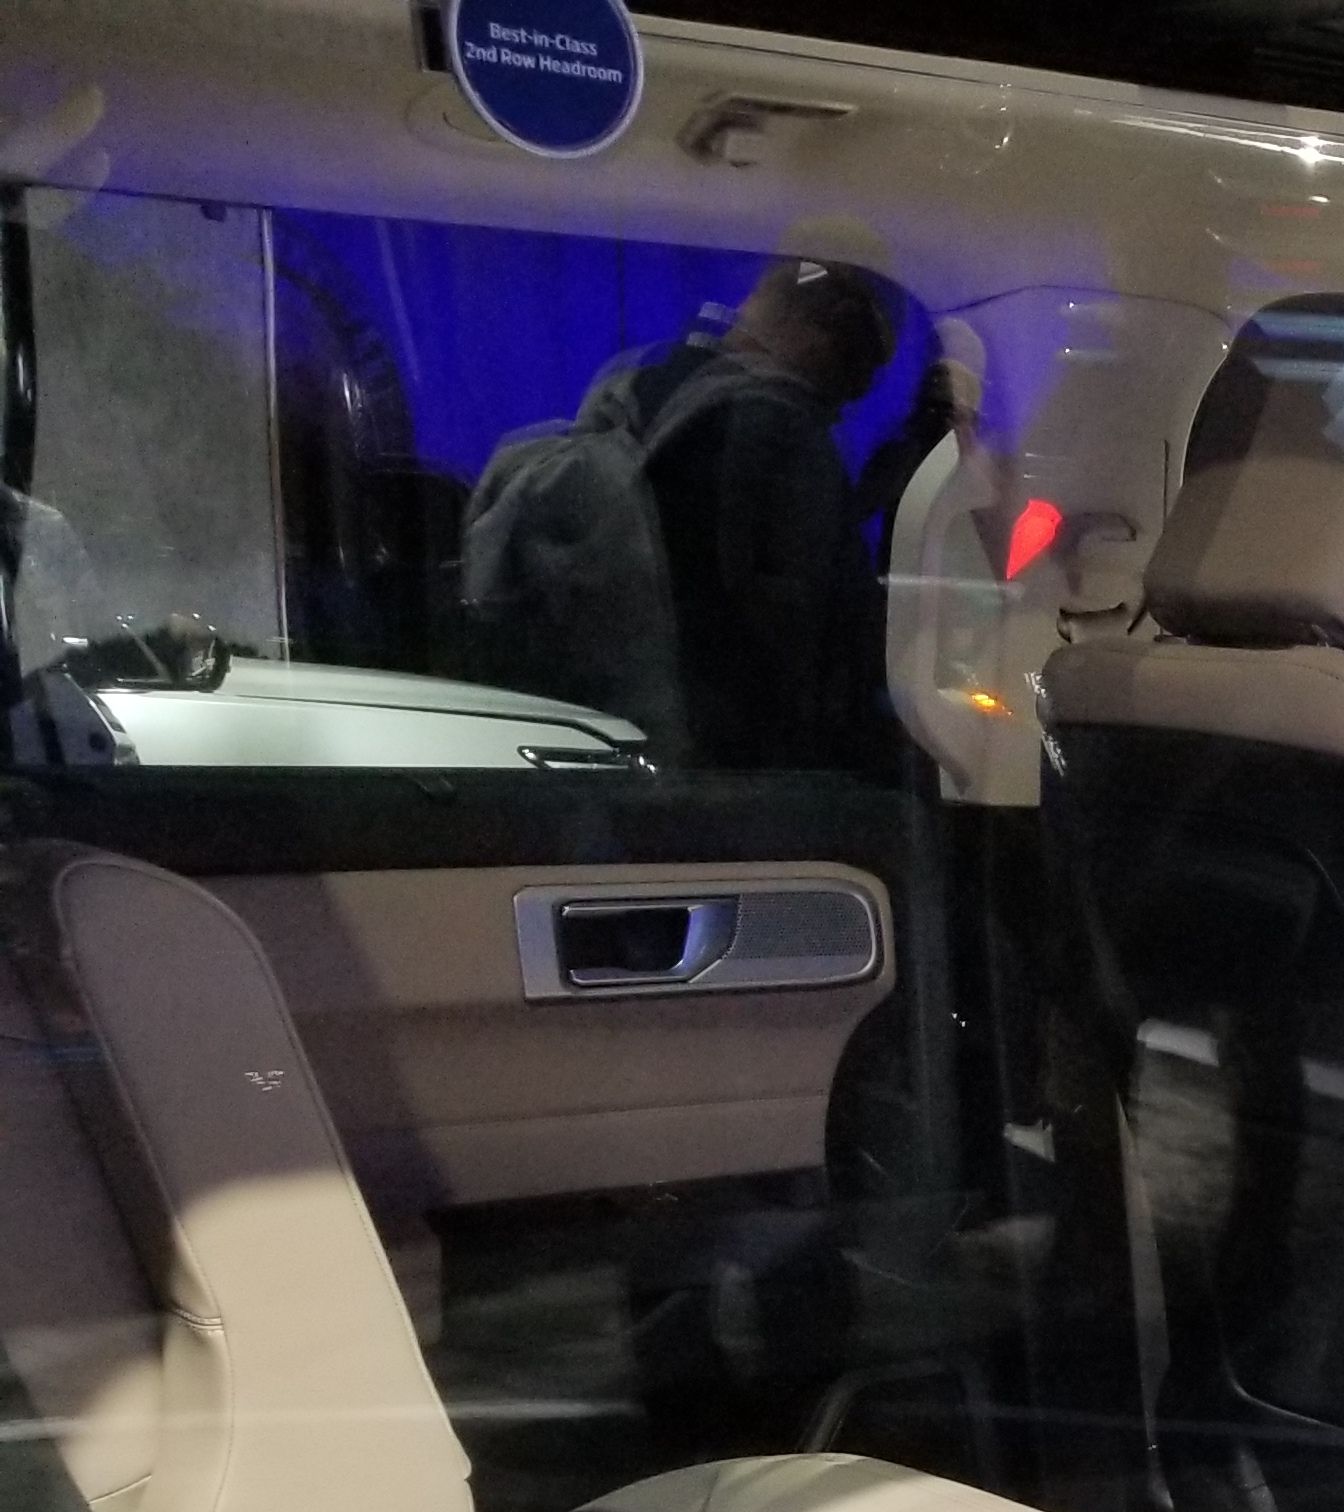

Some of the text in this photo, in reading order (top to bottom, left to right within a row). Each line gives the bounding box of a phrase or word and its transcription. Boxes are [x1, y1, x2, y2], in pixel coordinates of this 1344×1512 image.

[489, 22, 598, 57] Best-in-Class
[464, 41, 623, 84] 2nd Row Headroom
